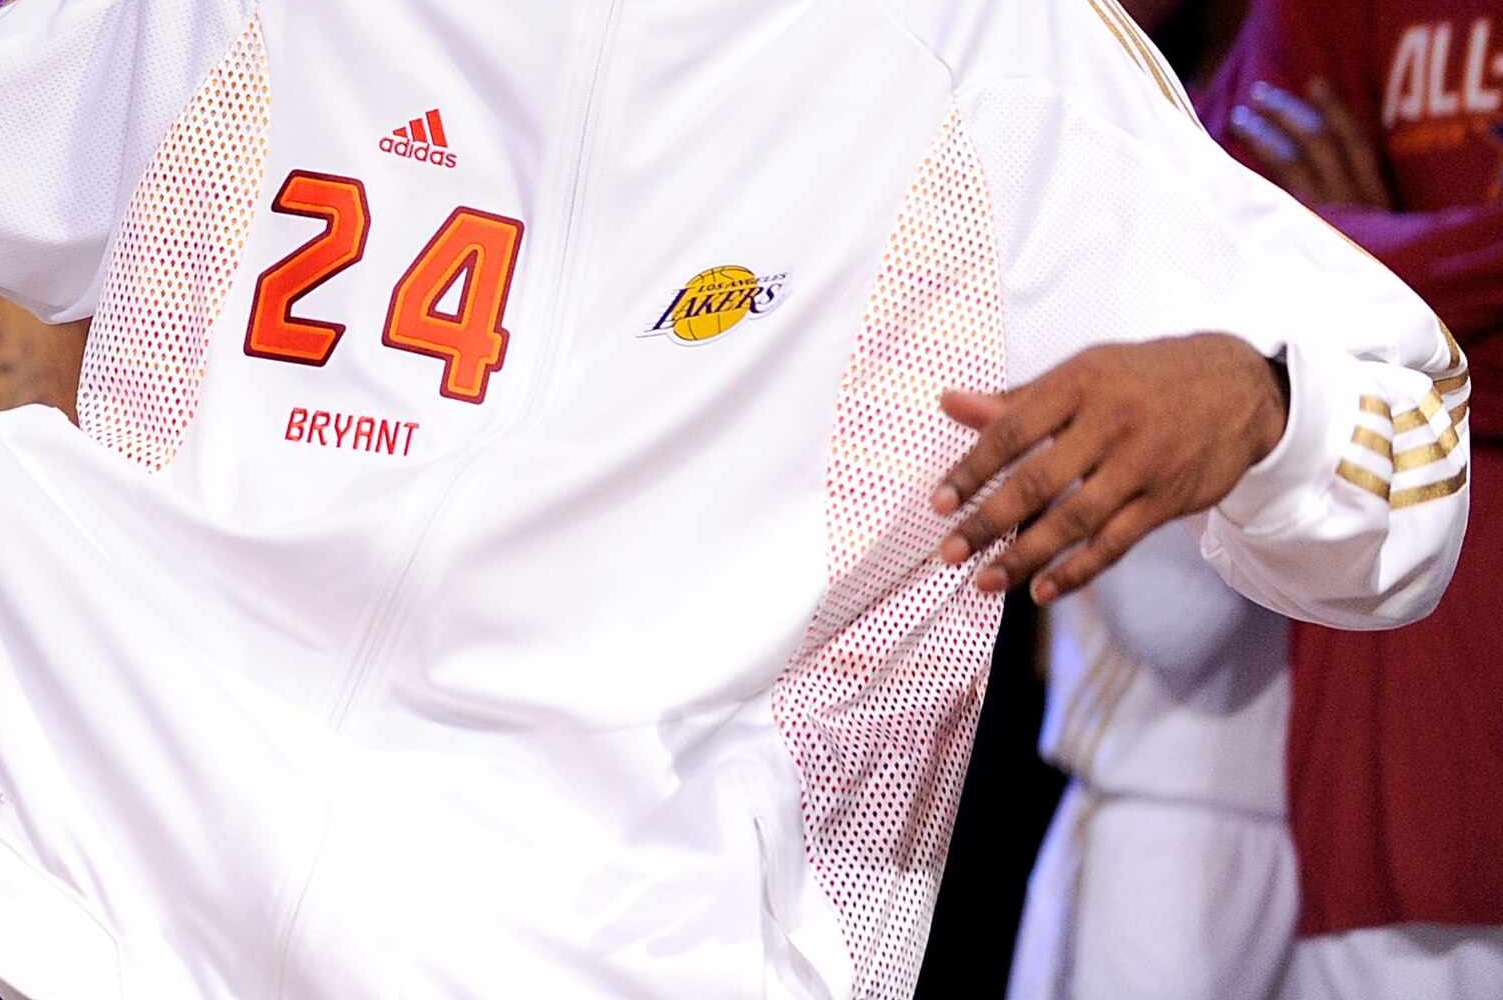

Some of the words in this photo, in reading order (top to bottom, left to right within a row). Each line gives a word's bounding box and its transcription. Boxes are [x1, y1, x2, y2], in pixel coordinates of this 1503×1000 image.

[378, 137, 458, 169] adidas
[243, 168, 525, 405] 24
[646, 282, 783, 332] LAKERS
[284, 406, 420, 457] BRYANT
